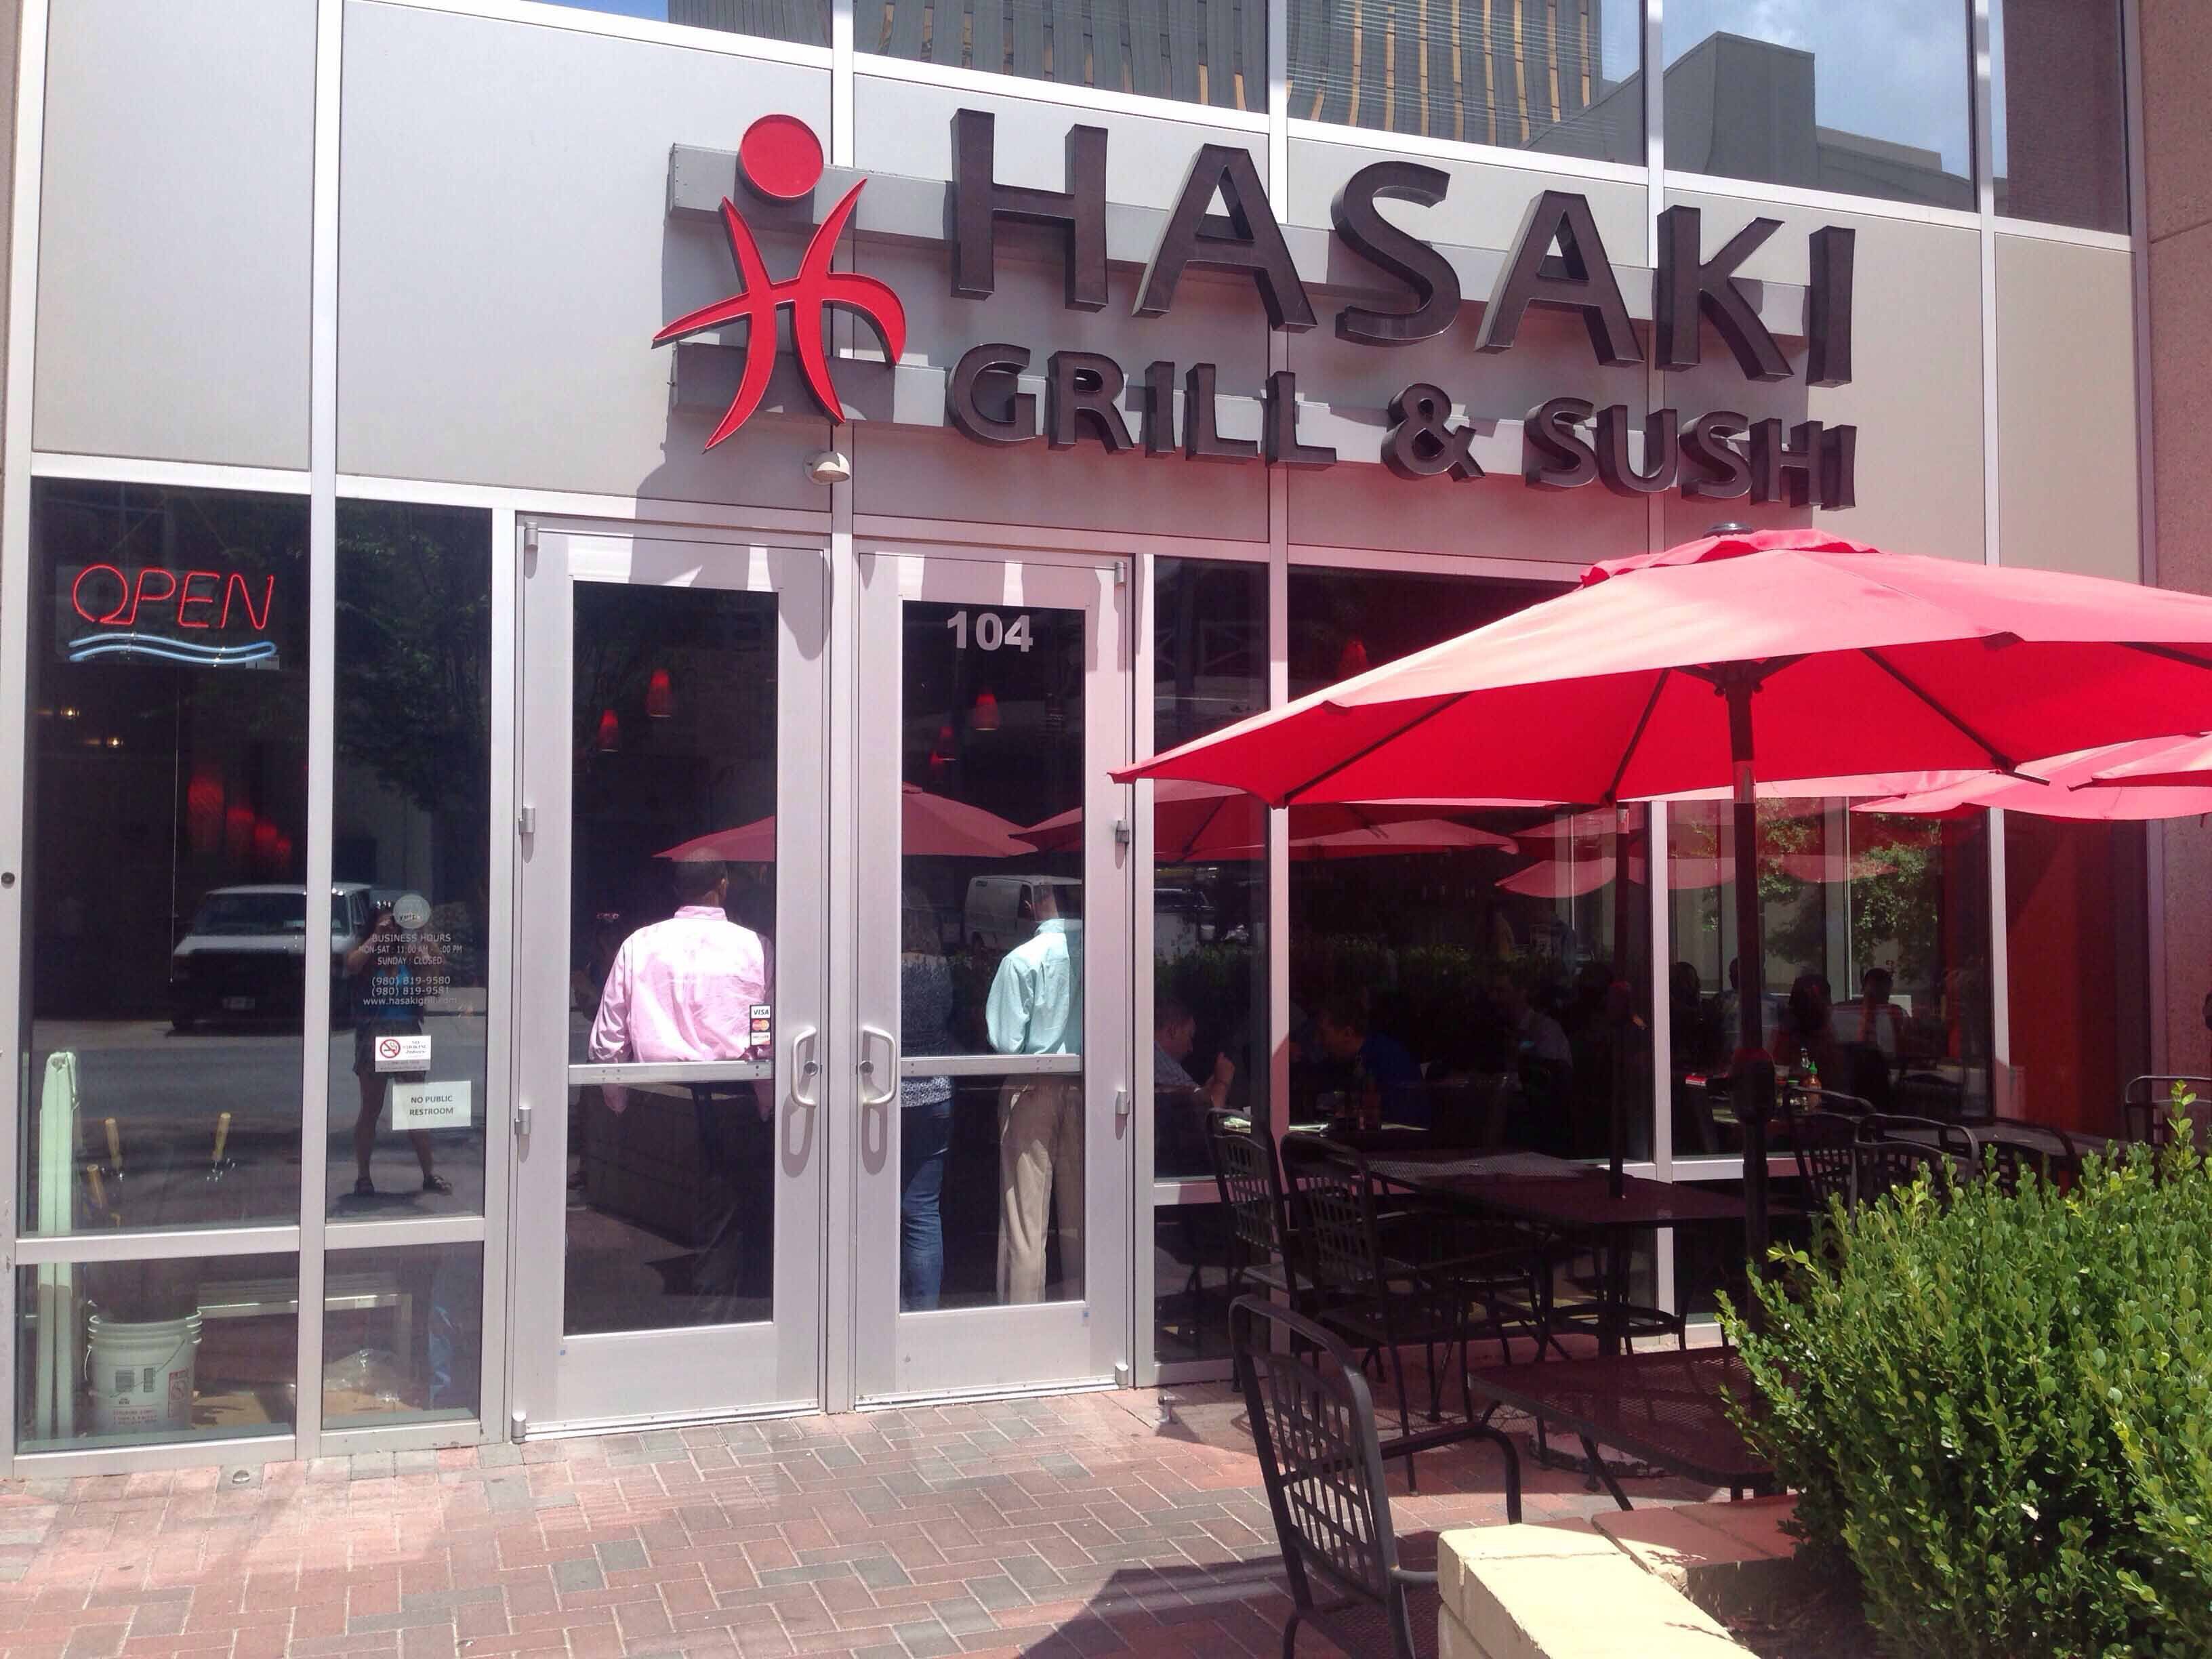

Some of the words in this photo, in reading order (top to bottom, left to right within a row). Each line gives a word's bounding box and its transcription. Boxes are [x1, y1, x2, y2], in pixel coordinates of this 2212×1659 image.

[951, 108, 1856, 387] HASAKI
[948, 343, 1336, 470] GRILL
[1380, 383, 1486, 482] &
[1524, 397, 1856, 512] SUSHI
[72, 564, 274, 630] OPEN
[947, 611, 1033, 653] 104
[372, 933, 418, 943] BUSINESS
[420, 933, 451, 943] HOURS
[452, 944, 464, 954] PM
[377, 956, 407, 966] SUNDAY
[413, 956, 443, 966] CLOSED
[371, 976, 399, 987] (980)
[403, 976, 451, 986] 819-9580
[371, 987, 399, 997] (980)
[403, 986, 449, 996] 819-9581
[411, 1096, 424, 1104] NO
[425, 1095, 453, 1103] PUBLIC
[409, 1107, 454, 1116] RESTROOM
